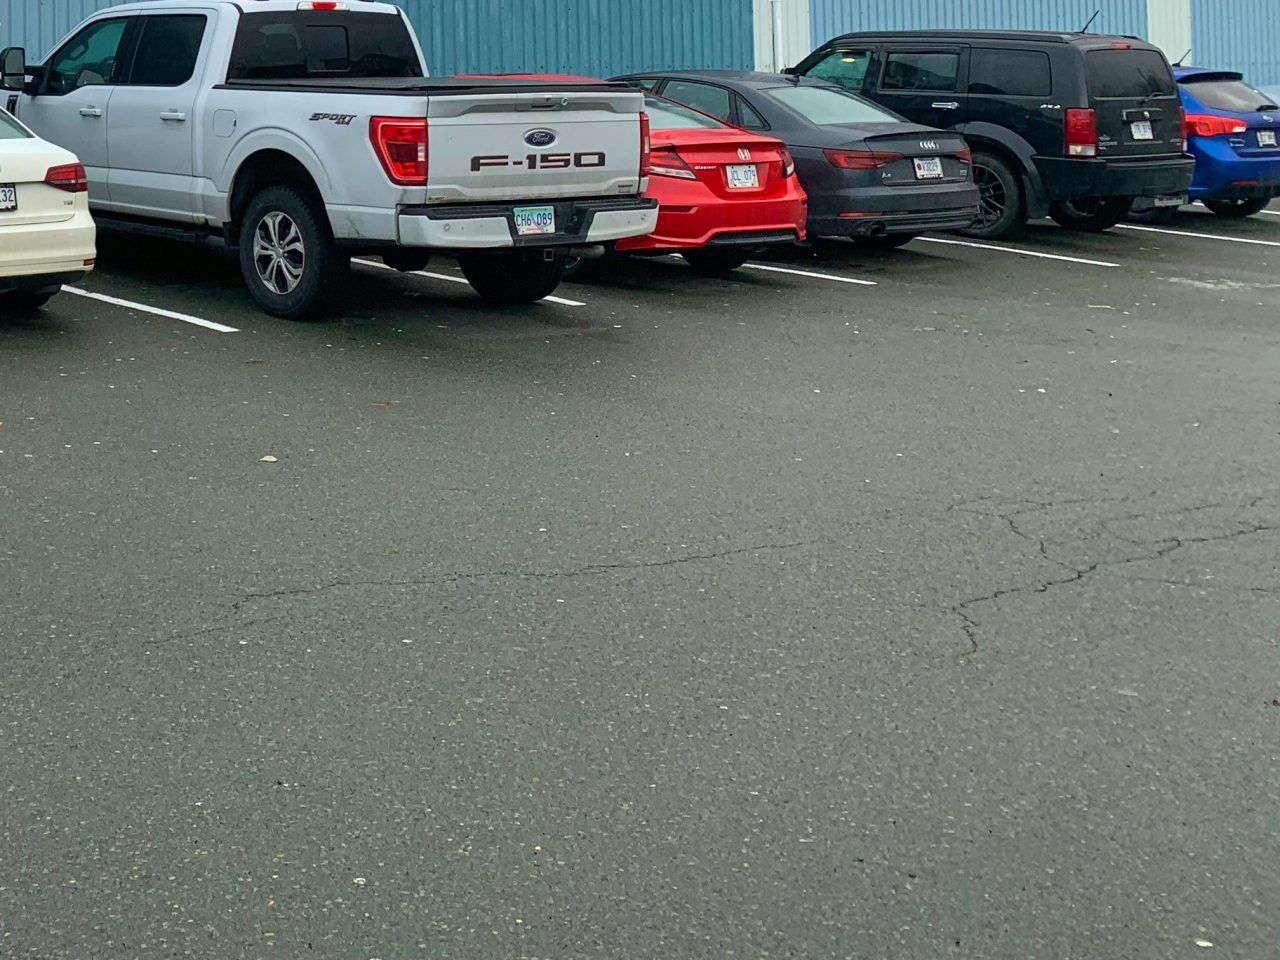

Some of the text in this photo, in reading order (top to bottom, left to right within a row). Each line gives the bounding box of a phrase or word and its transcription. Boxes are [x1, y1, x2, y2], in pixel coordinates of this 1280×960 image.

[309, 112, 358, 124] SPORT
[470, 151, 606, 172] F-150
[536, 212, 553, 226] 089
